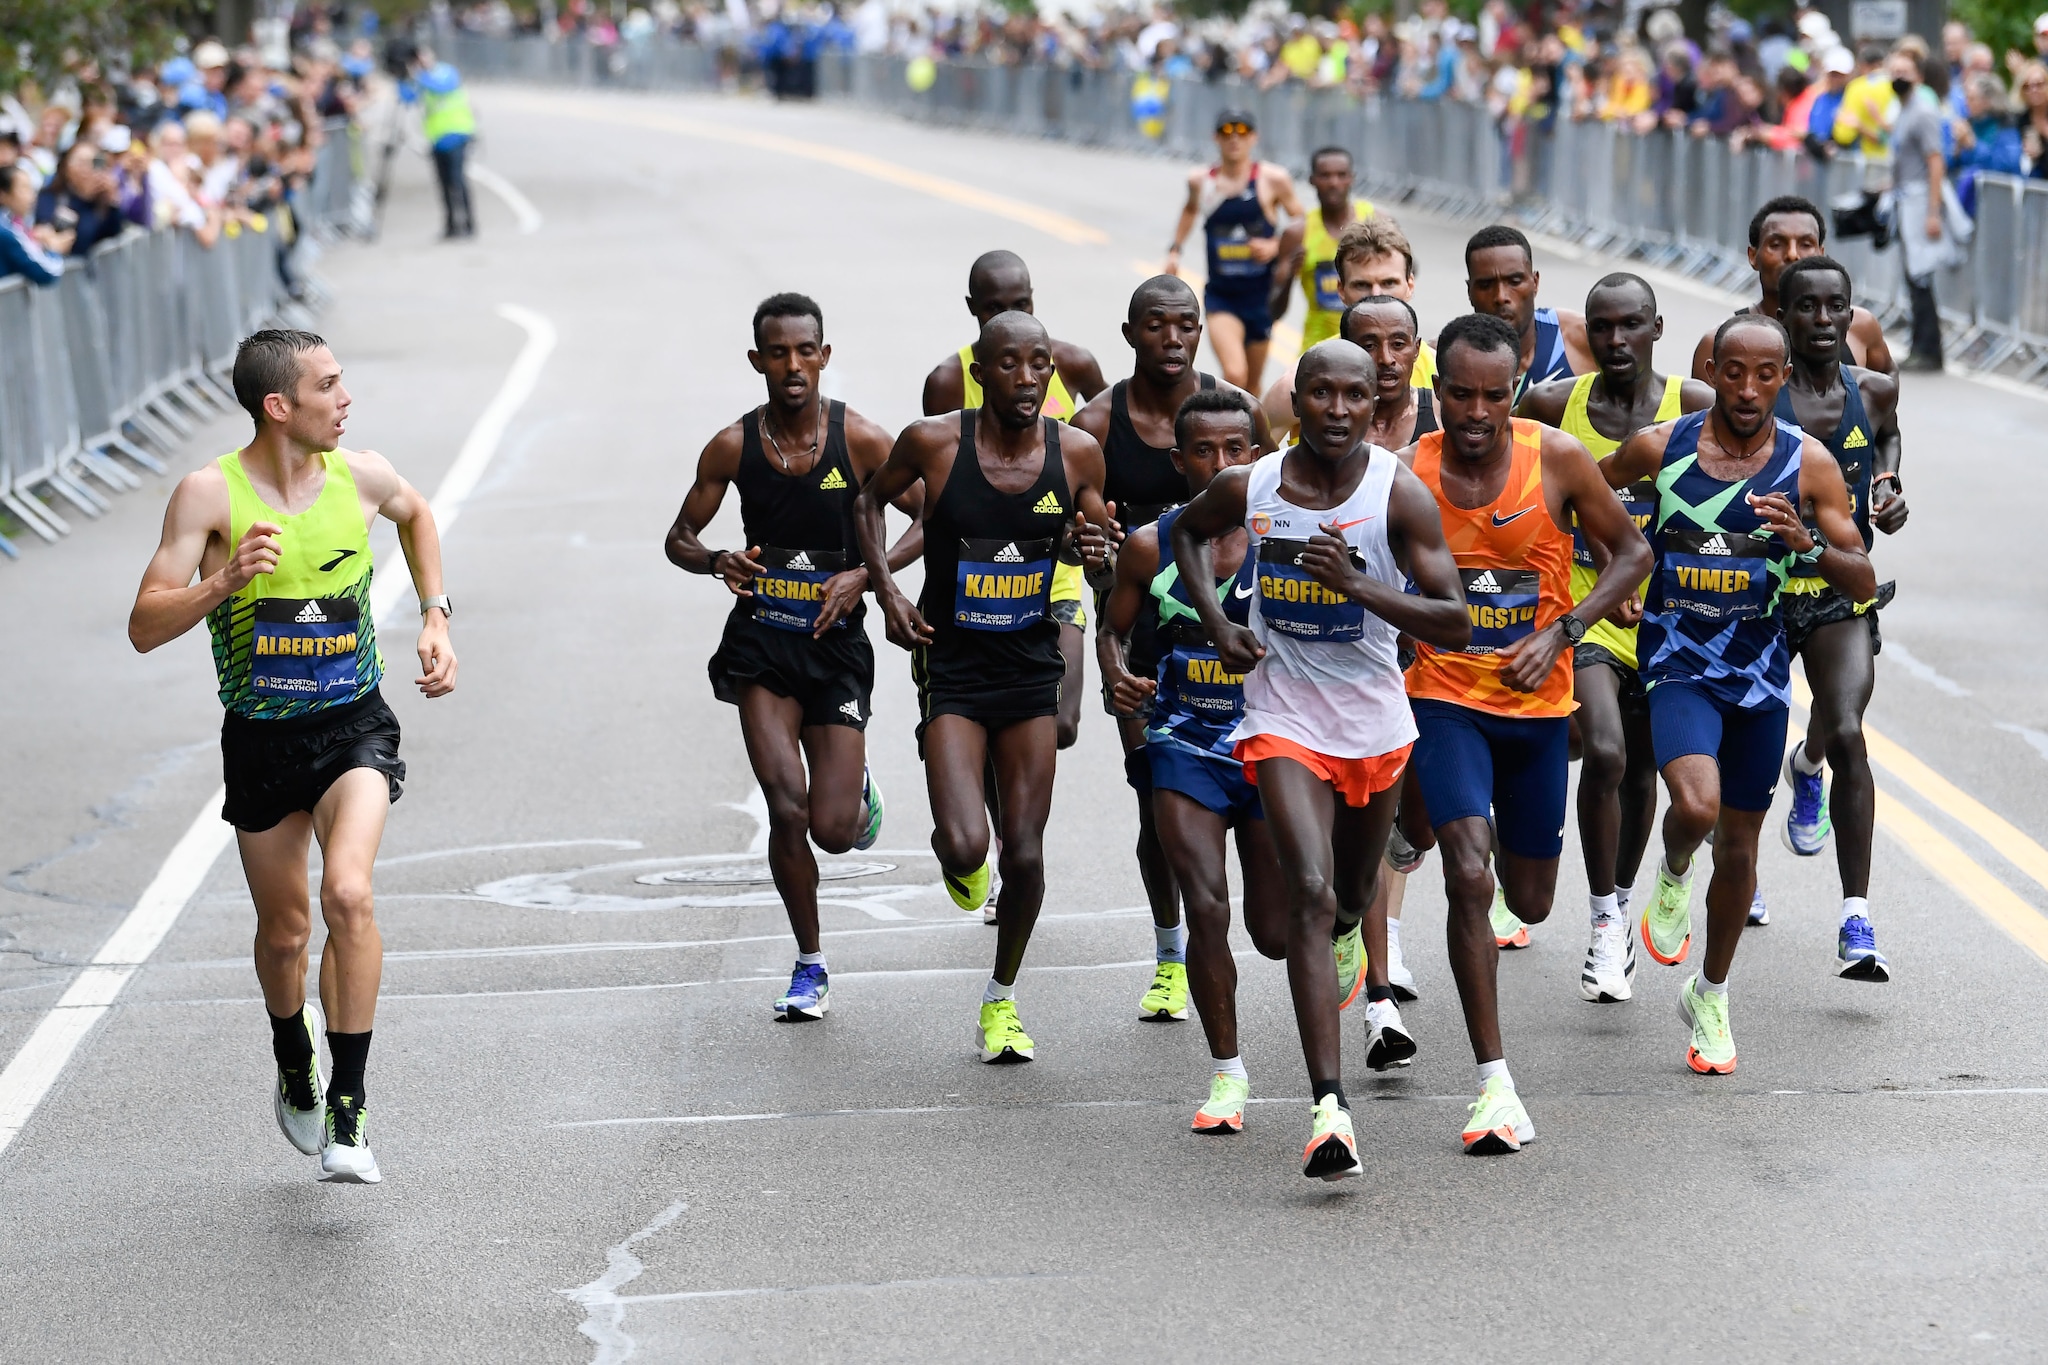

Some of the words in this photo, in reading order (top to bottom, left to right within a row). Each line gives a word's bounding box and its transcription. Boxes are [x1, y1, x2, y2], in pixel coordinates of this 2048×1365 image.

[1843, 440, 1868, 449] adidas
[820, 481, 847, 490] adidas
[1033, 505, 1063, 514] adidas
[1274, 520, 1290, 528] NN
[1699, 546, 1731, 556] adidas
[994, 554, 1024, 563] adidas
[786, 562, 815, 571] adidas
[1676, 565, 1750, 593] YIMER
[965, 572, 1044, 599] KANDIE
[1260, 575, 1348, 605] GEOFFR
[1468, 584, 1502, 593] adidas
[1694, 602, 1720, 613] BOSTON
[294, 614, 327, 623] adidas
[782, 613, 807, 623] BOSTON
[1466, 603, 1535, 629] NGSTU
[970, 617, 1013, 626] MARATHON
[1290, 621, 1319, 630] BOSTON
[256, 632, 357, 657] ALBERTSON
[287, 678, 317, 687] BOSTON
[270, 683, 318, 693] MARATHON
[1205, 697, 1232, 705] BOSTON
